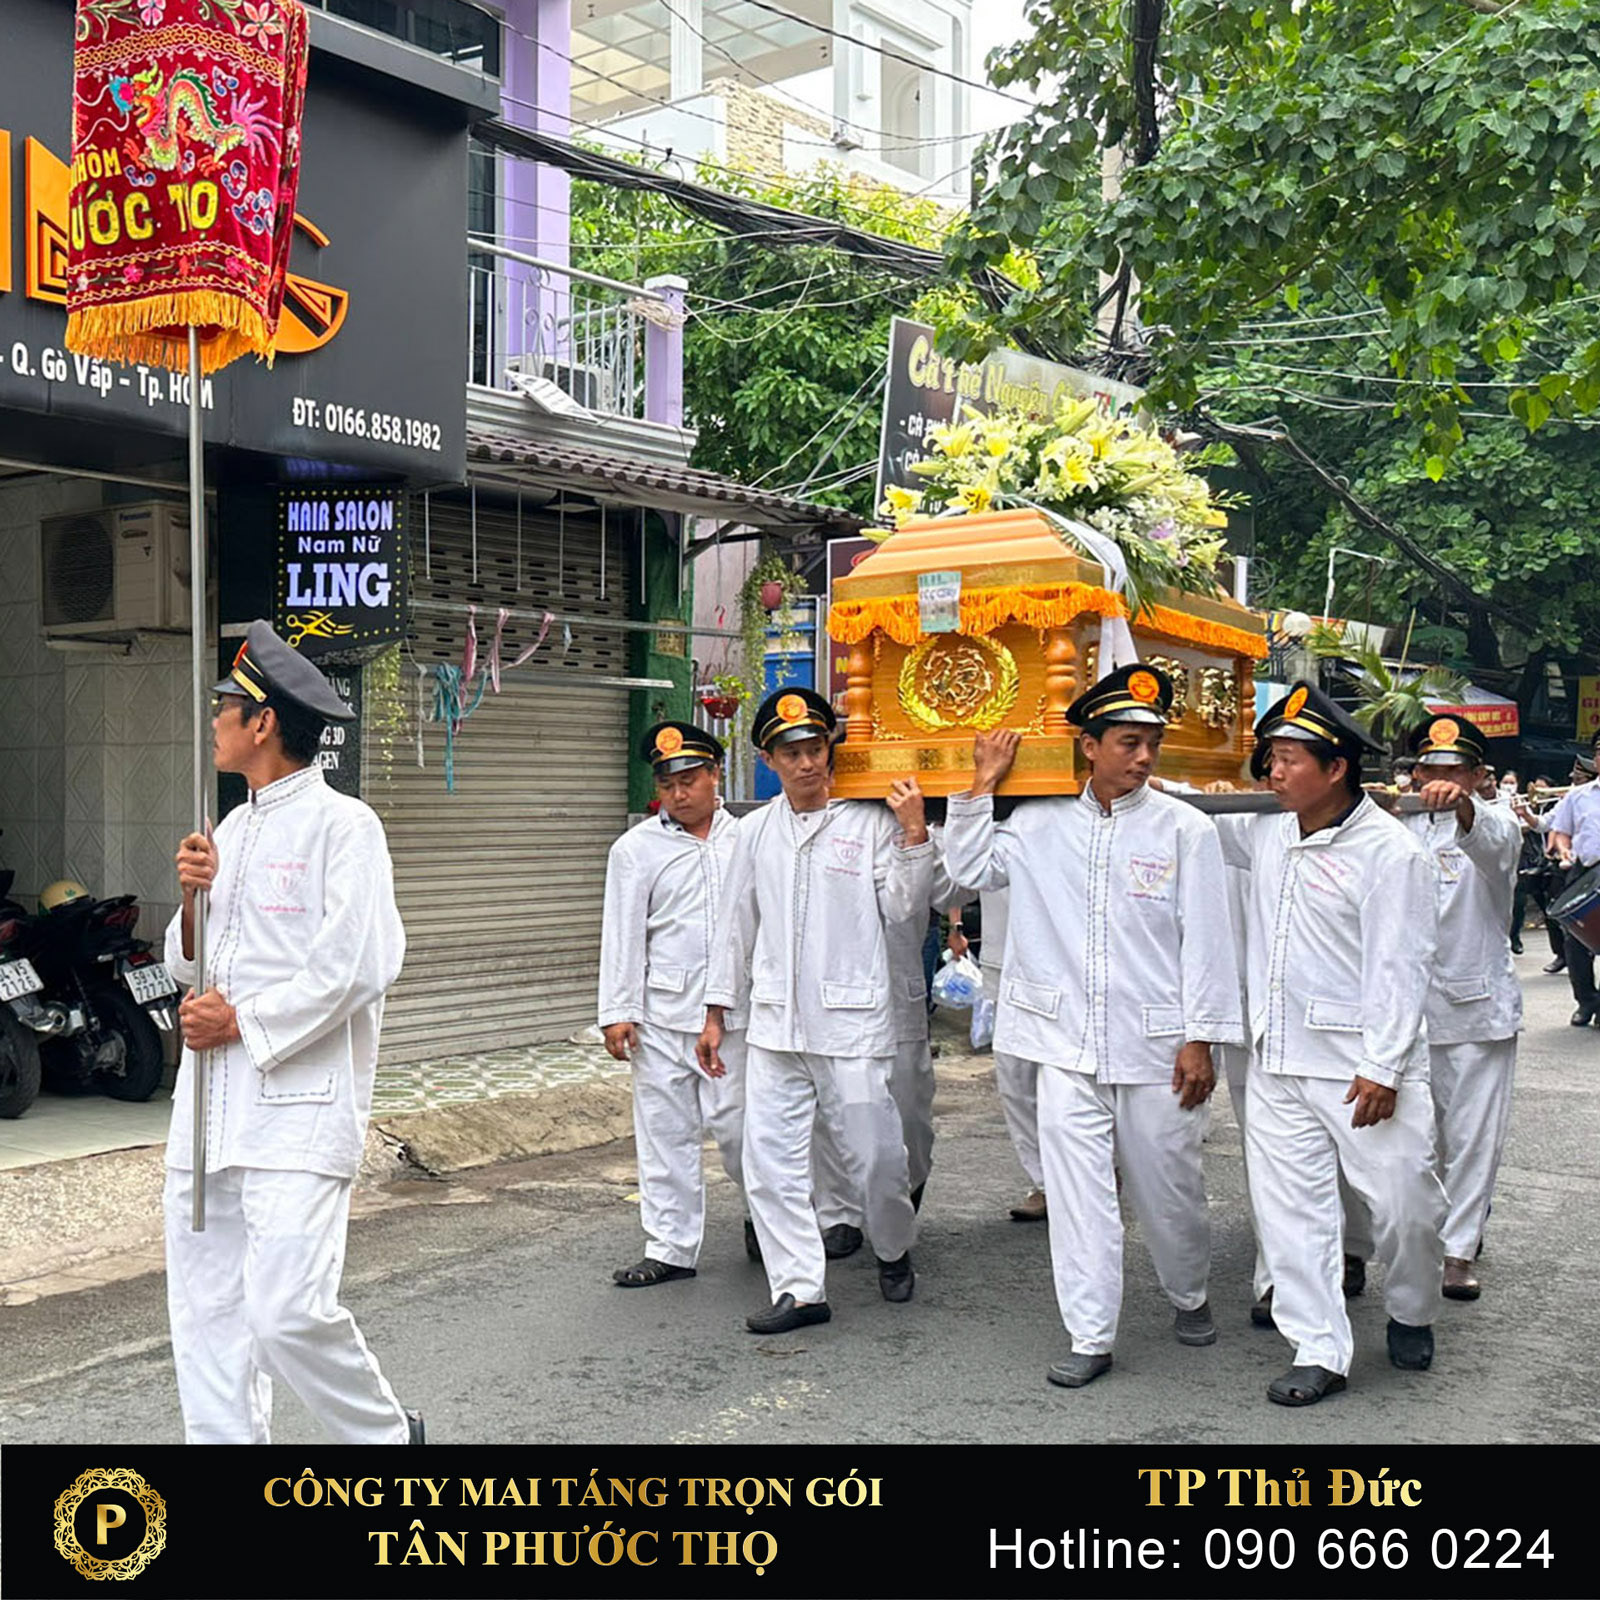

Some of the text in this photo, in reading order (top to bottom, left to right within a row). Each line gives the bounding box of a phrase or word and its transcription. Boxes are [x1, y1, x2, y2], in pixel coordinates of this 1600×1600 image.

[12, 342, 36, 377] Q.
[41, 348, 68, 382] Gò
[137, 365, 164, 406] Tp.
[292, 397, 441, 451] ĐT: 0166.858.1982
[288, 500, 394, 532] HAIR SALON
[298, 534, 382, 553] Nam Nữ
[286, 562, 392, 608] LING
